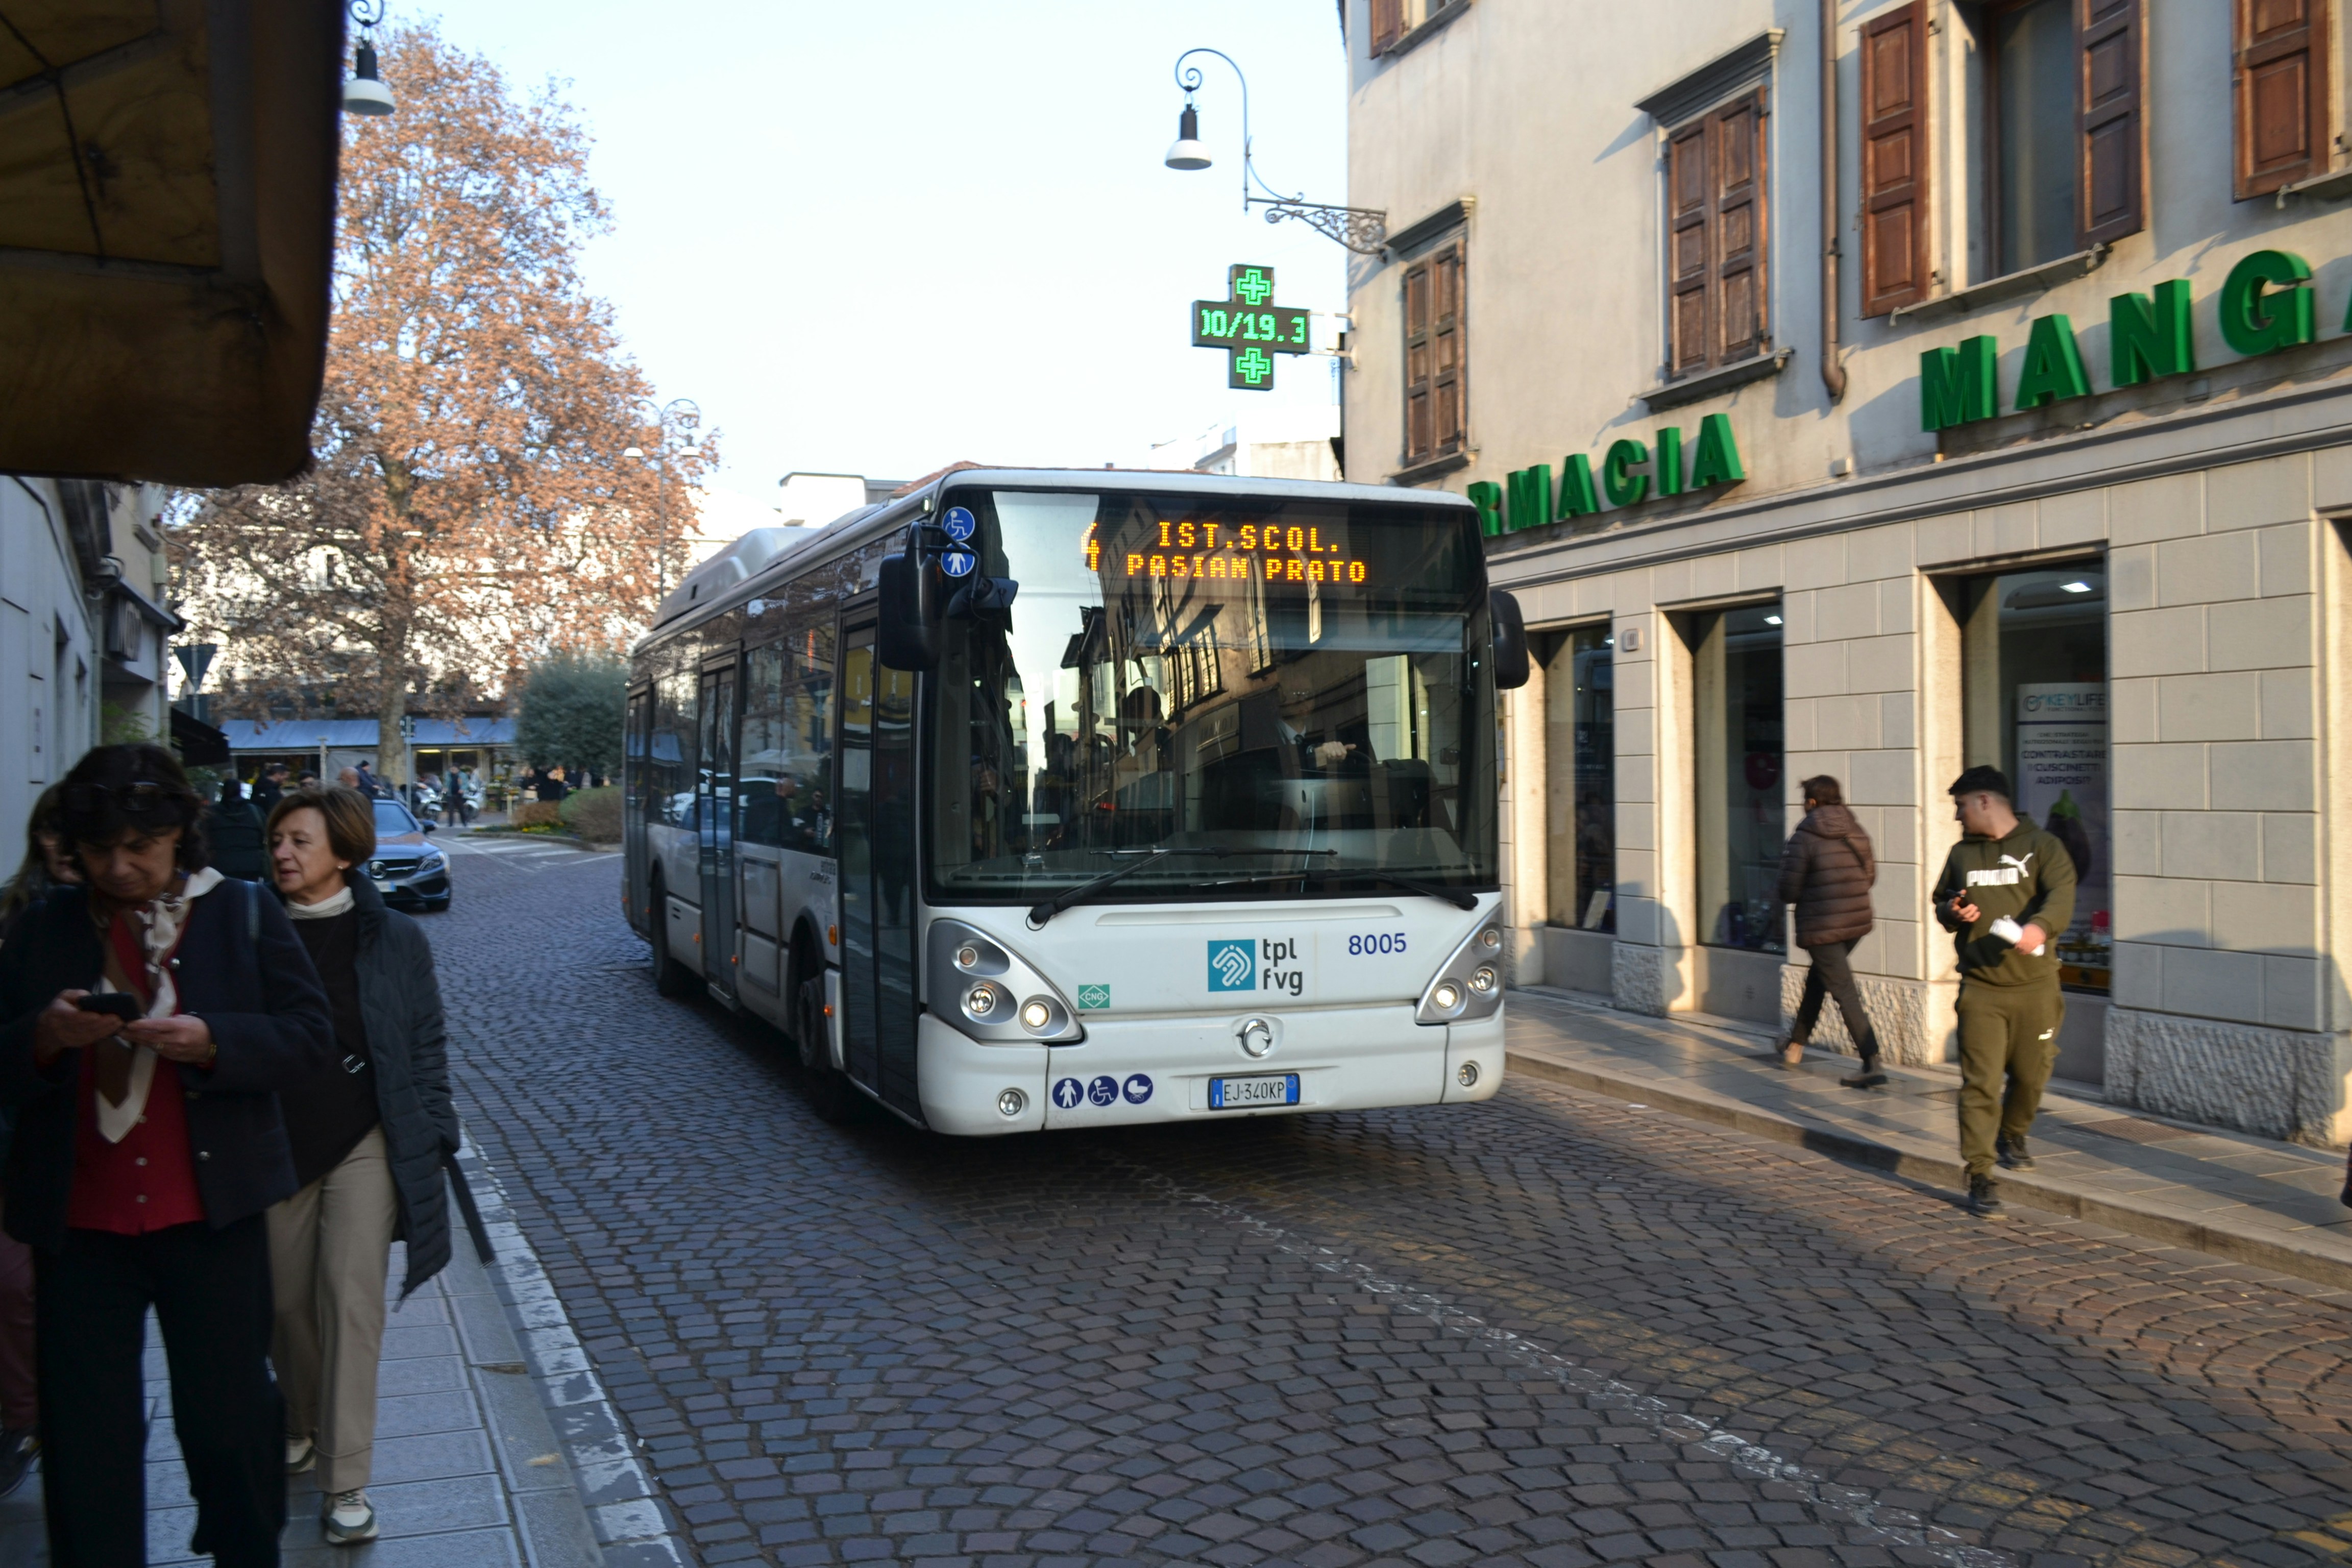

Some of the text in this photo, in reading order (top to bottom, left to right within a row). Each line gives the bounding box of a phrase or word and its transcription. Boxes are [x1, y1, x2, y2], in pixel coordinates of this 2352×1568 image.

[1921, 249, 2352, 432] MANG
[1081, 522, 1099, 571] 4
[1127, 554, 1365, 582] PASIAN PRATO
[1967, 868, 2019, 887] PUMA
[1262, 938, 1297, 968] tpl
[1348, 933, 1407, 955] 8005
[1263, 968, 1303, 996] fvg
[1085, 992, 1104, 1001] CNG
